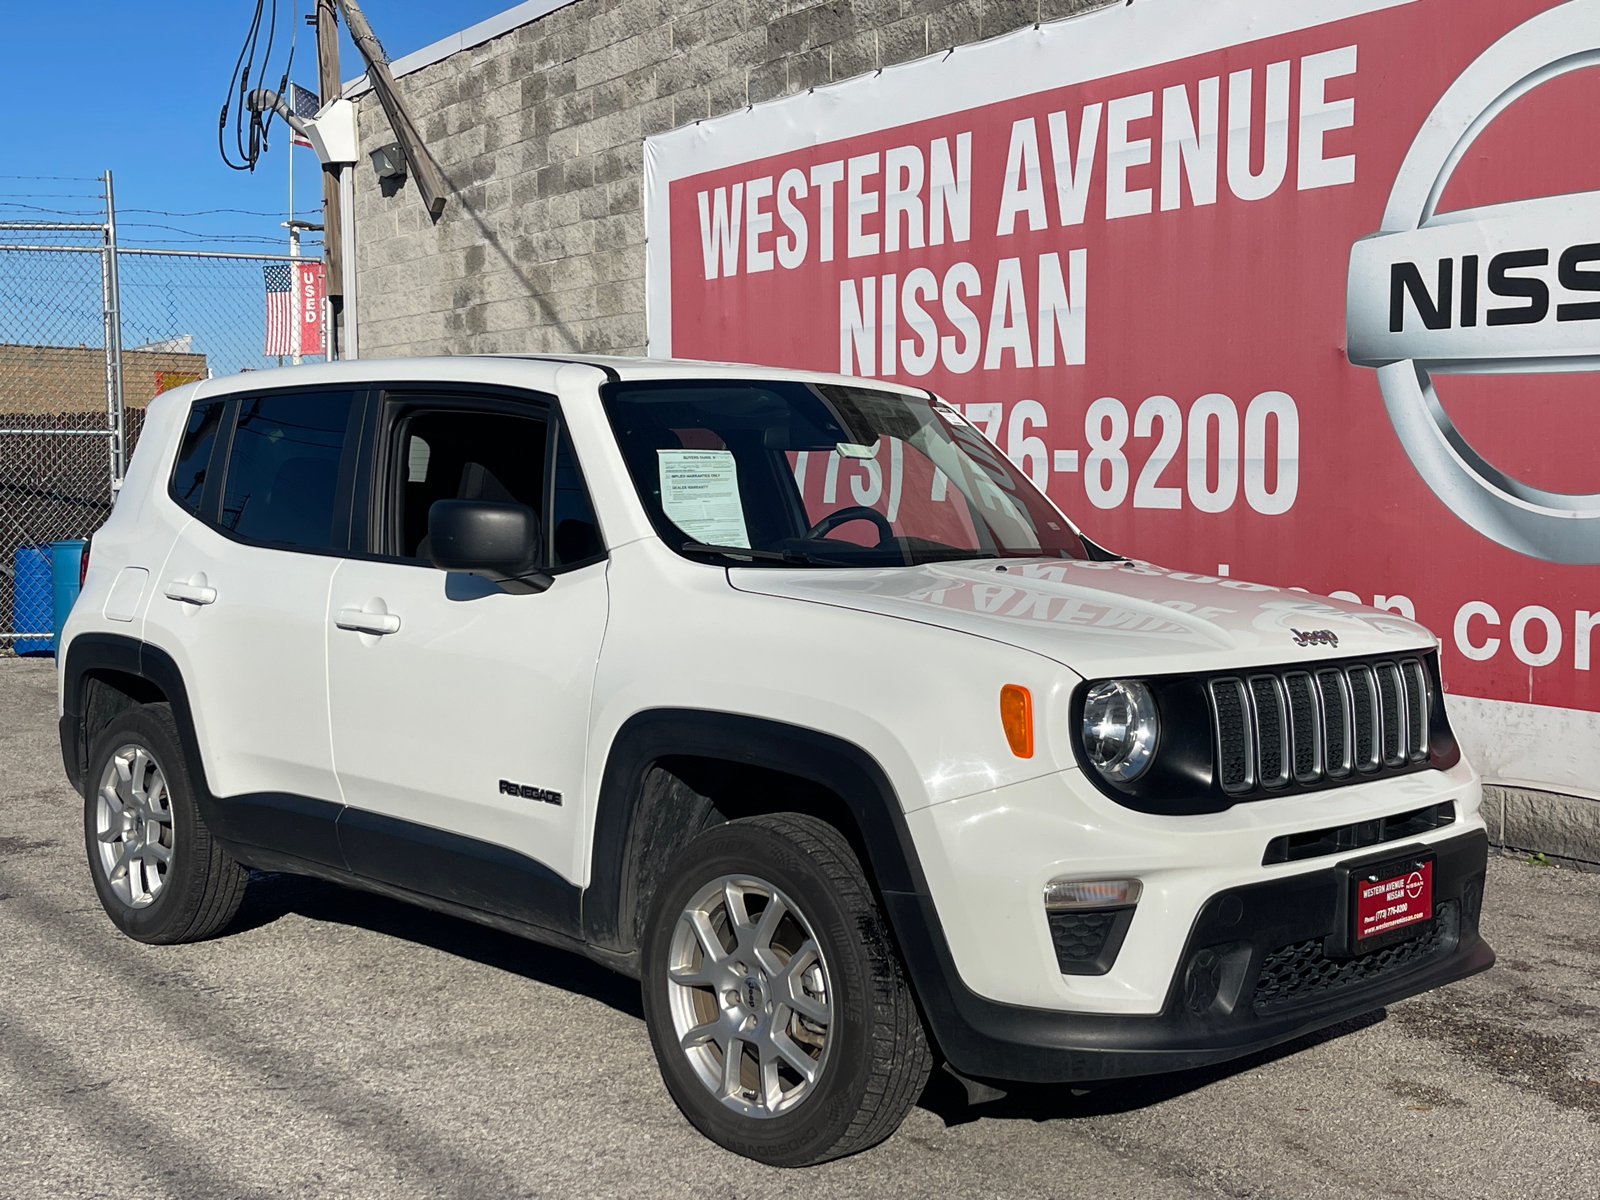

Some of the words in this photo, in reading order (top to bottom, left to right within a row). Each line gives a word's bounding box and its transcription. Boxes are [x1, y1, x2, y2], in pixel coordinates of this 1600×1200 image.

[698, 131, 972, 281] WESTERN
[996, 45, 1358, 237] AVENUE
[303, 271, 317, 323] USED
[839, 248, 1088, 377] NISSAN
[1290, 627, 1340, 649] Jeep
[499, 779, 563, 807] RENEGADE
[1363, 883, 1385, 898] WESTERN
[1386, 879, 1404, 892] AVENUE
[1387, 889, 1404, 901] NISSAN
[1406, 881, 1424, 889] NISSAN
